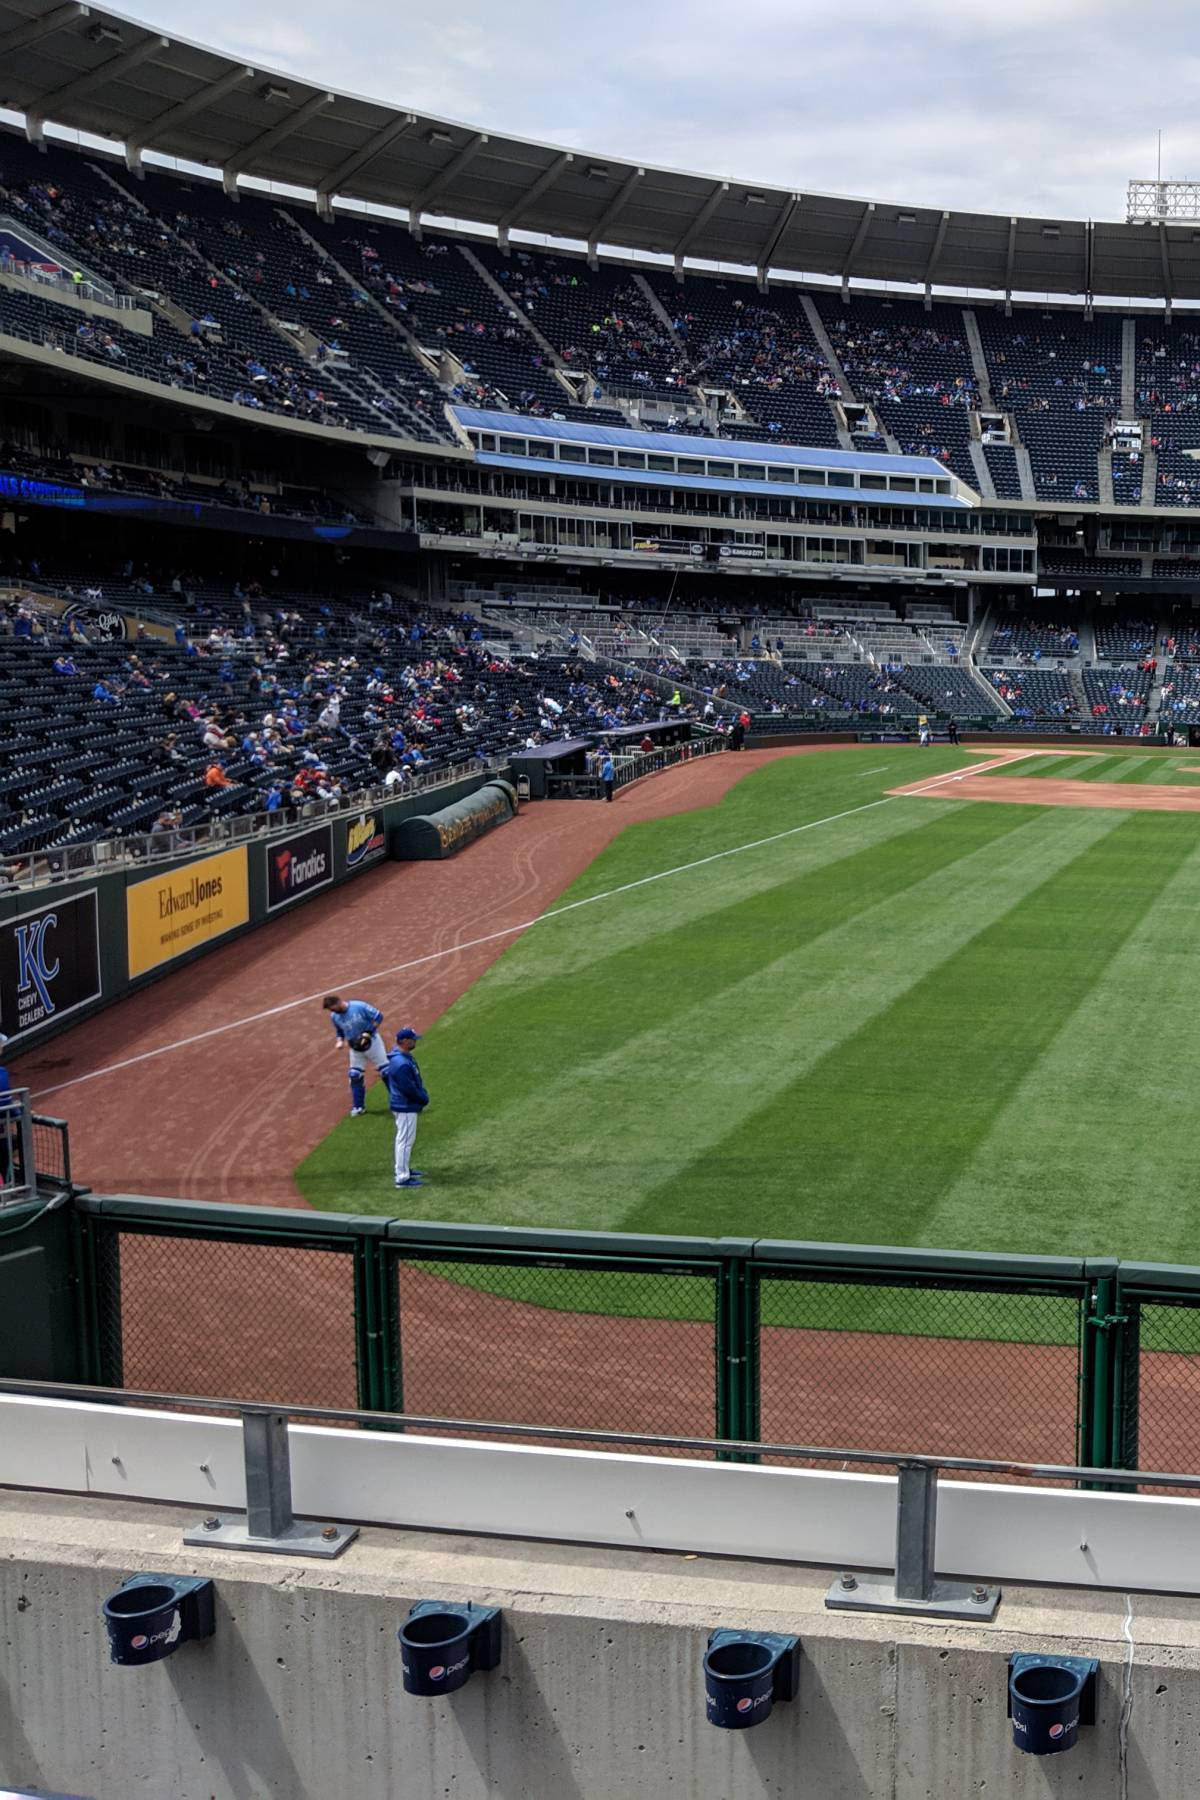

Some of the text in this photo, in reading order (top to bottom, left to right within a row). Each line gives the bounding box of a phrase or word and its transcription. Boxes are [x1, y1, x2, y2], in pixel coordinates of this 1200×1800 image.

[291, 849, 326, 887] Fanatics
[15, 913, 60, 1014] KC
[18, 992, 38, 1010] CHEVY
[19, 1006, 45, 1027] DEALERS
